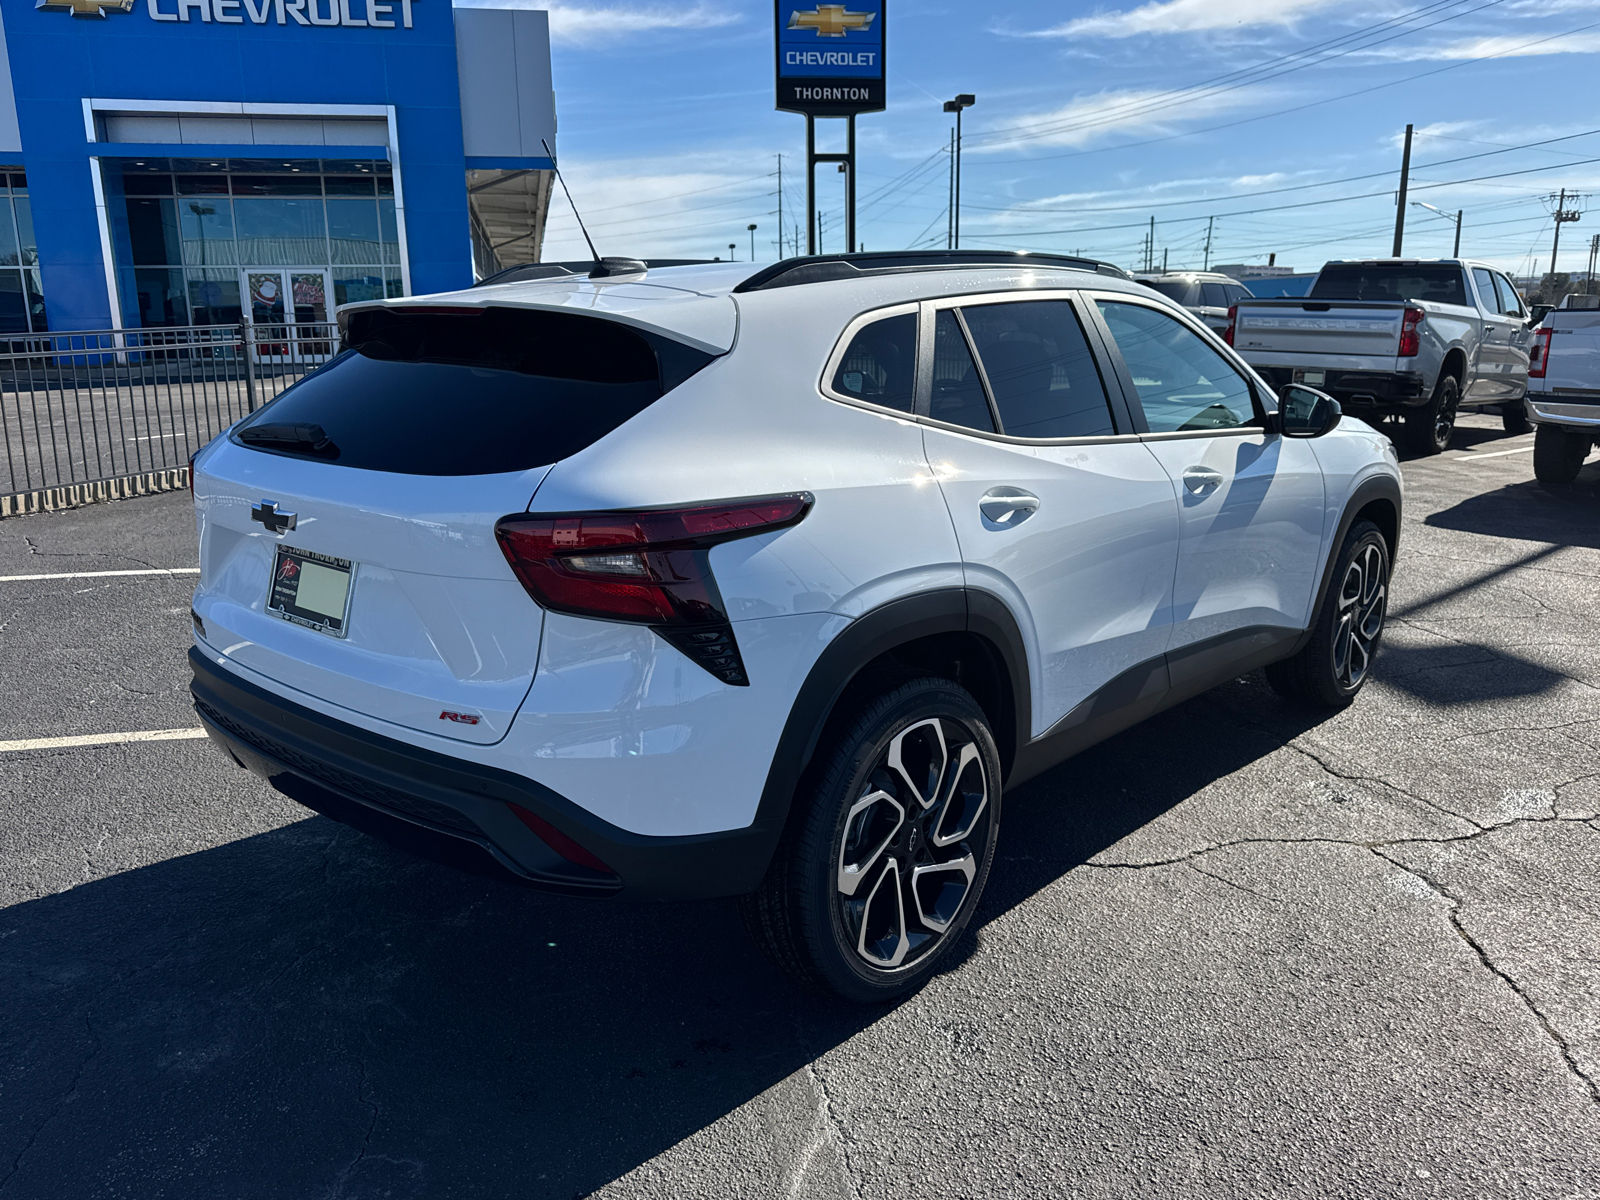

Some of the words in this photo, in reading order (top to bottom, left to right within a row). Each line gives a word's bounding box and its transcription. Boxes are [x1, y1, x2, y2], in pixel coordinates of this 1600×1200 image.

[148, 0, 414, 28] CHEVROLET
[786, 51, 876, 66] CHEVROLET
[794, 87, 869, 100] THORNTON
[1245, 318, 1390, 330] CHEVROLET
[439, 709, 482, 725] RS
